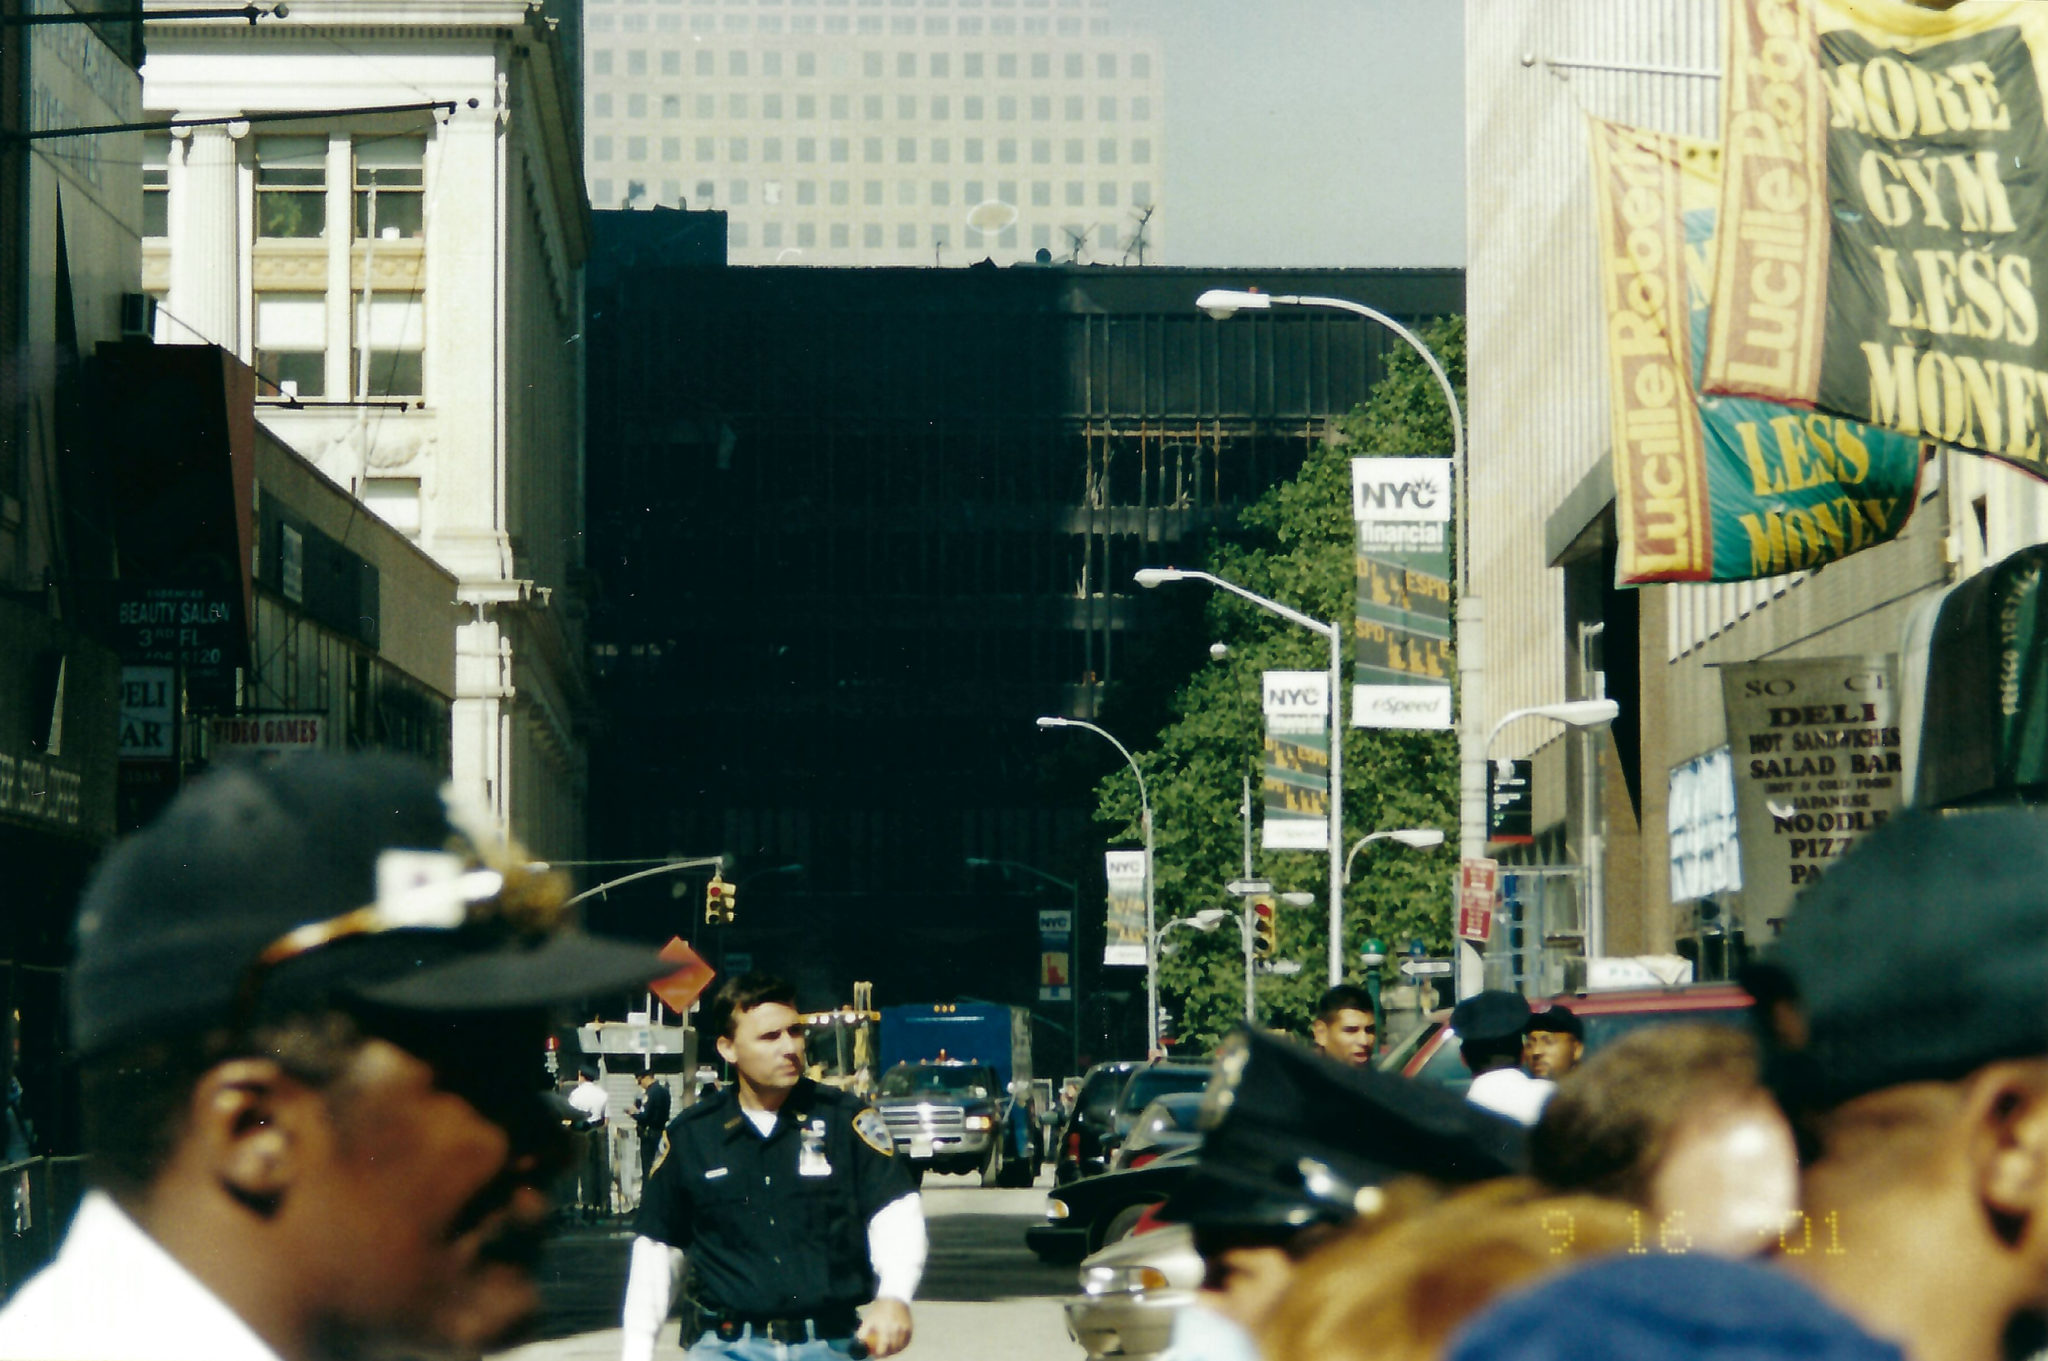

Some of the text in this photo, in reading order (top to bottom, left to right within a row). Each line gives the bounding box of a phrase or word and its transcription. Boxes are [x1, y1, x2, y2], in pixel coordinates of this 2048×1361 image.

[1820, 57, 2011, 141] MORE
[1727, 0, 1808, 383] Lucille Robe
[1860, 149, 2018, 233] GYM
[1873, 245, 2039, 346] LESS
[1627, 361, 1691, 566] Lucille
[1734, 413, 1870, 496] LESS
[1362, 477, 1438, 509] NYC
[1361, 521, 1443, 543] financial
[119, 600, 231, 624] BEAUTY SALON
[138, 628, 175, 648] 3RD
[1269, 686, 1319, 706] NYC
[1745, 678, 1796, 698] SO
[1768, 703, 1878, 727] DELI
[119, 720, 164, 748] AR
[212, 718, 318, 744] VIDEO GAMES
[1749, 727, 1901, 754] HOT SANDWICHES
[1750, 752, 1902, 779] SALAD BAR
[1789, 837, 1853, 859] PIZZ
